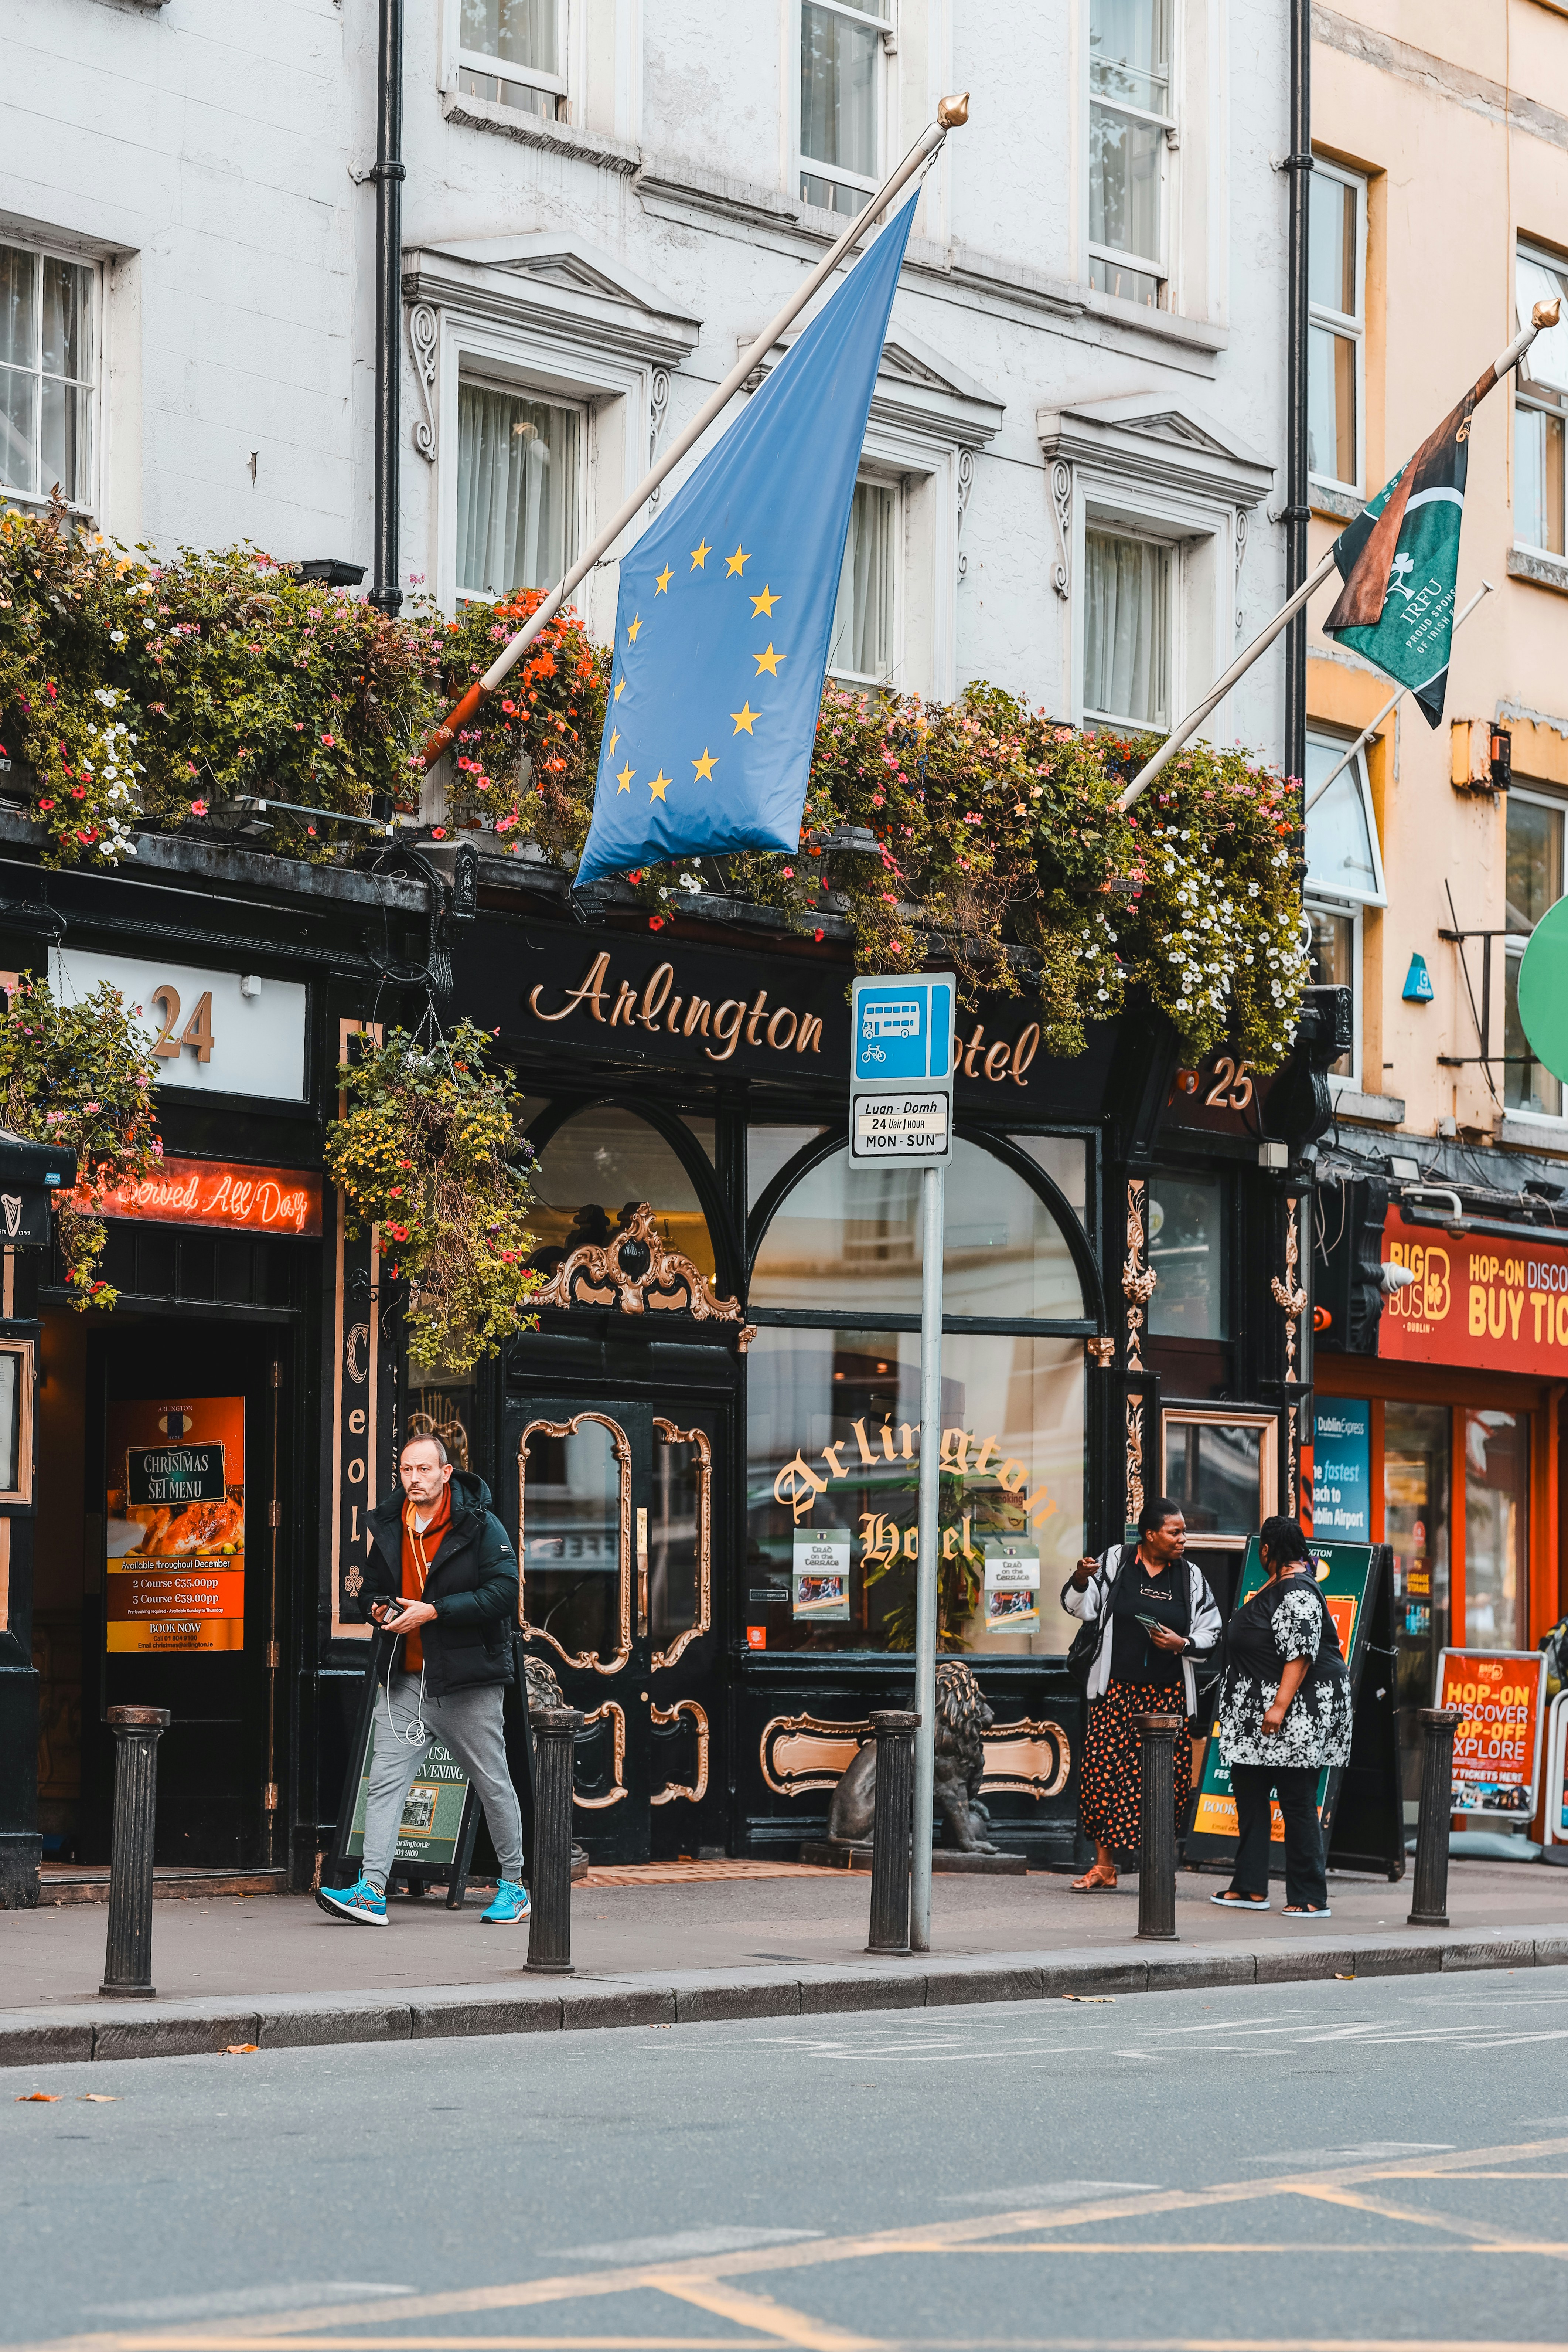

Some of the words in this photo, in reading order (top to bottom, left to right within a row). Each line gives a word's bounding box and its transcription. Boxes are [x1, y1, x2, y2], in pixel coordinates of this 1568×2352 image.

[1400, 578, 1442, 625] IRFU
[1405, 618, 1432, 648] PROUD
[1417, 640, 1428, 653] OF
[1427, 616, 1450, 641] IRISH
[529, 951, 823, 1061] Arlington
[151, 985, 215, 1063] 24
[1204, 1057, 1255, 1110] 25
[865, 1103, 895, 1115] Luan
[903, 1101, 937, 1114] Domh
[872, 1119, 886, 1129] 24
[889, 1119, 902, 1129] Uair
[907, 1120, 924, 1128] HOUR
[866, 1135, 896, 1148] MON
[906, 1134, 935, 1147] SUN
[202, 1176, 252, 1215] All
[256, 1182, 307, 1225] Day
[1469, 1253, 1525, 1287] HOP-ON
[1527, 1261, 1568, 1293] DISCO
[1388, 1284, 1424, 1319] BUS
[1468, 1284, 1525, 1341] BUY
[1407, 1321, 1430, 1334] DUBLIN
[144, 1448, 209, 1474] CHRISTMAS
[773, 1412, 1059, 1529] Arlington
[1323, 1460, 1360, 1484] fastest
[148, 1475, 174, 1499] SET
[169, 1481, 202, 1498] MENU
[1331, 1486, 1341, 1503] to
[1312, 1506, 1333, 1525] ublin
[1334, 1508, 1364, 1530] Airport
[858, 1513, 977, 1570] Hoel
[122, 1560, 154, 1571] Available
[156, 1559, 193, 1570] throughout
[194, 1559, 231, 1568] December
[140, 1579, 173, 1588] Course
[174, 1578, 218, 1589] €35.00pp
[133, 1595, 139, 1604] 3
[140, 1594, 173, 1604] Course
[174, 1594, 219, 1604] €39.00pp
[150, 1623, 175, 1633] BOOK
[178, 1622, 202, 1633] NOW
[1447, 1682, 1530, 1707] HOP-ON
[1454, 1720, 1527, 1741] OP-OFF
[425, 1746, 454, 1761] USIC
[1452, 1738, 1526, 1761] XPLORE
[1459, 1769, 1499, 1781] TICKETS
[1499, 1771, 1523, 1783] HERE
[1203, 1800, 1236, 1816] BOOK
